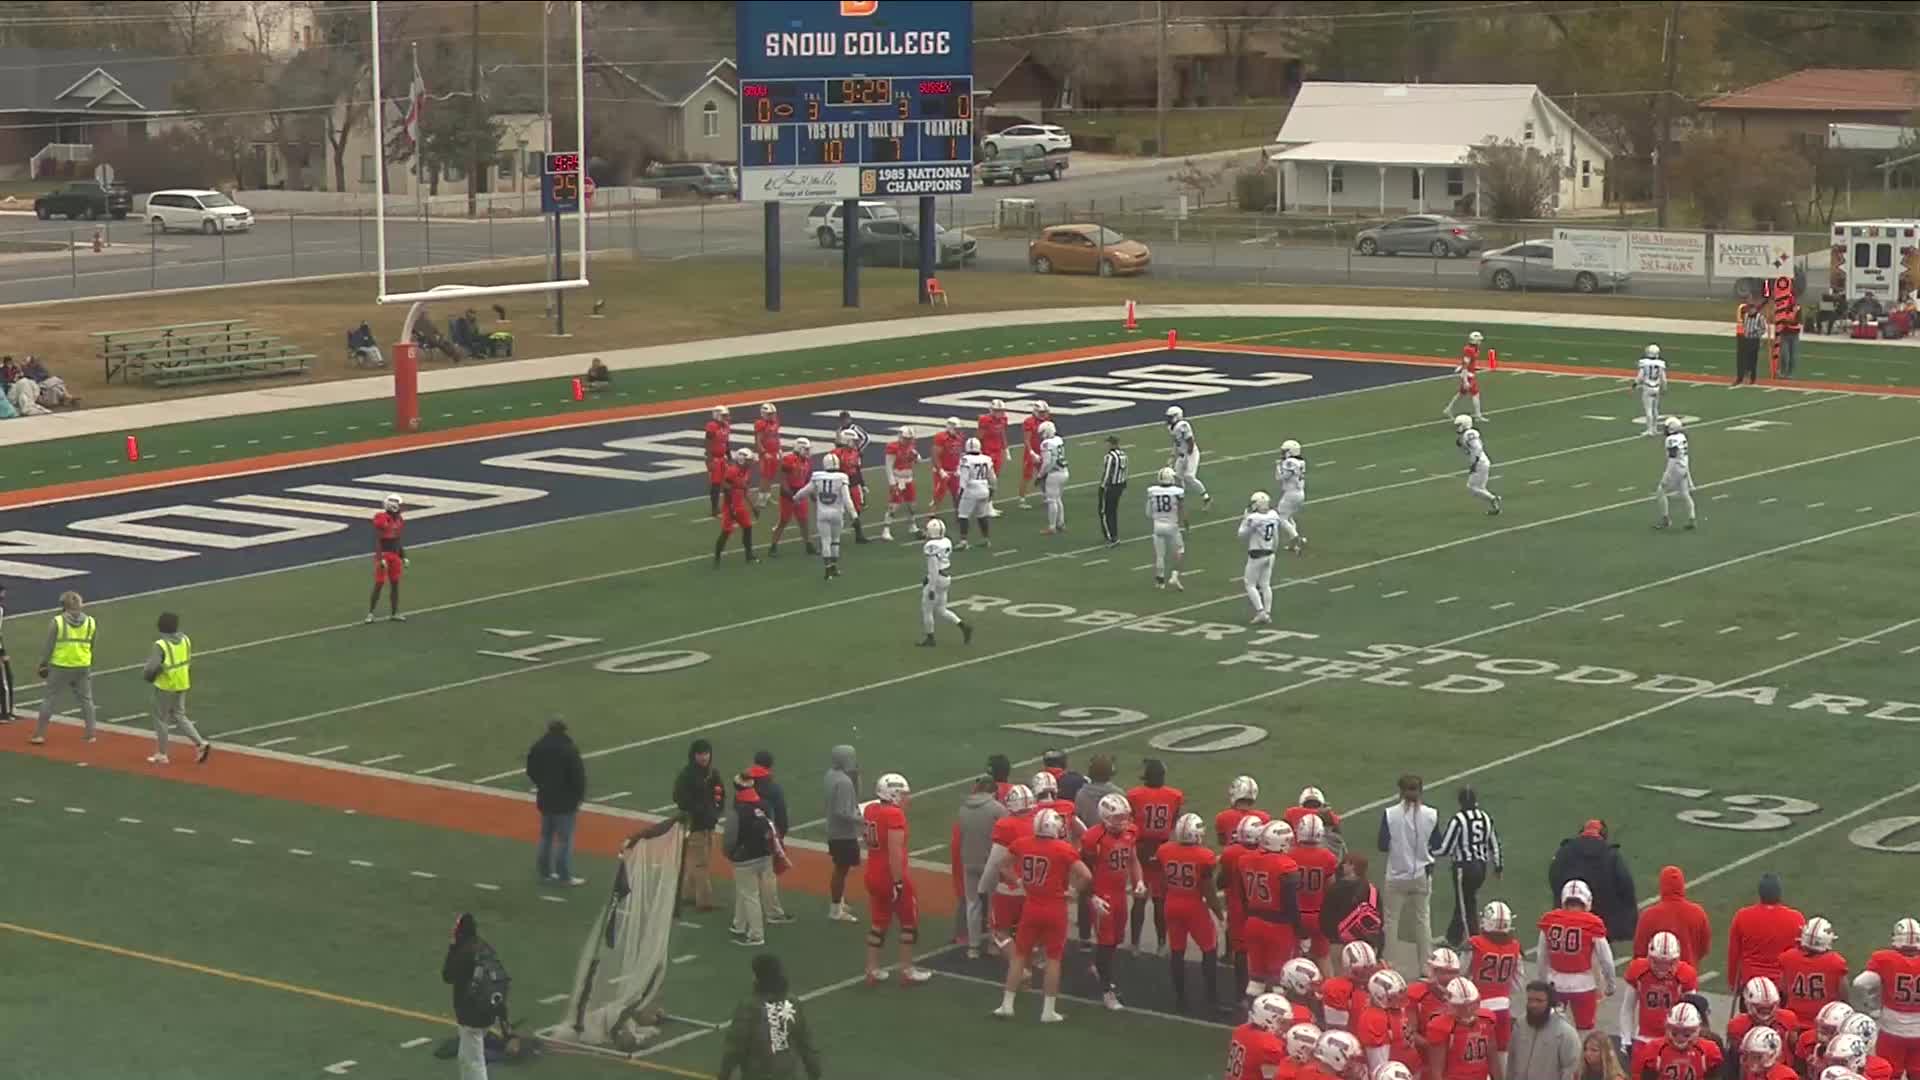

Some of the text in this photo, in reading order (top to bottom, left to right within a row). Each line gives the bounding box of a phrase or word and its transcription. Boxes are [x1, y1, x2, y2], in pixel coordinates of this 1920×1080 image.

[766, 31, 951, 57] SNOW COLLEGE
[809, 102, 819, 120] 3
[899, 99, 909, 120] 3
[958, 95, 970, 119] 0
[750, 125, 779, 141] DOWN
[924, 120, 968, 136] QUARTER
[824, 140, 842, 163] 10
[889, 139, 901, 161] 7
[878, 167, 970, 181] 1985 NATIONAL
[887, 179, 962, 193] CHAMPIONS
[553, 175, 577, 200] 25
[1155, 494, 1172, 513] 18
[1265, 522, 1275, 541] 0
[945, 595, 1319, 645] ROBERT
[1218, 650, 1505, 693] FIELD
[1000, 706, 1269, 752] 20
[1143, 804, 1169, 830] 18
[1471, 820, 1484, 843] S
[1022, 854, 1048, 887] 97
[1166, 862, 1195, 889] 26
[1243, 869, 1272, 904] 75
[1479, 952, 1514, 983] 20
[1791, 972, 1825, 1000] 46
